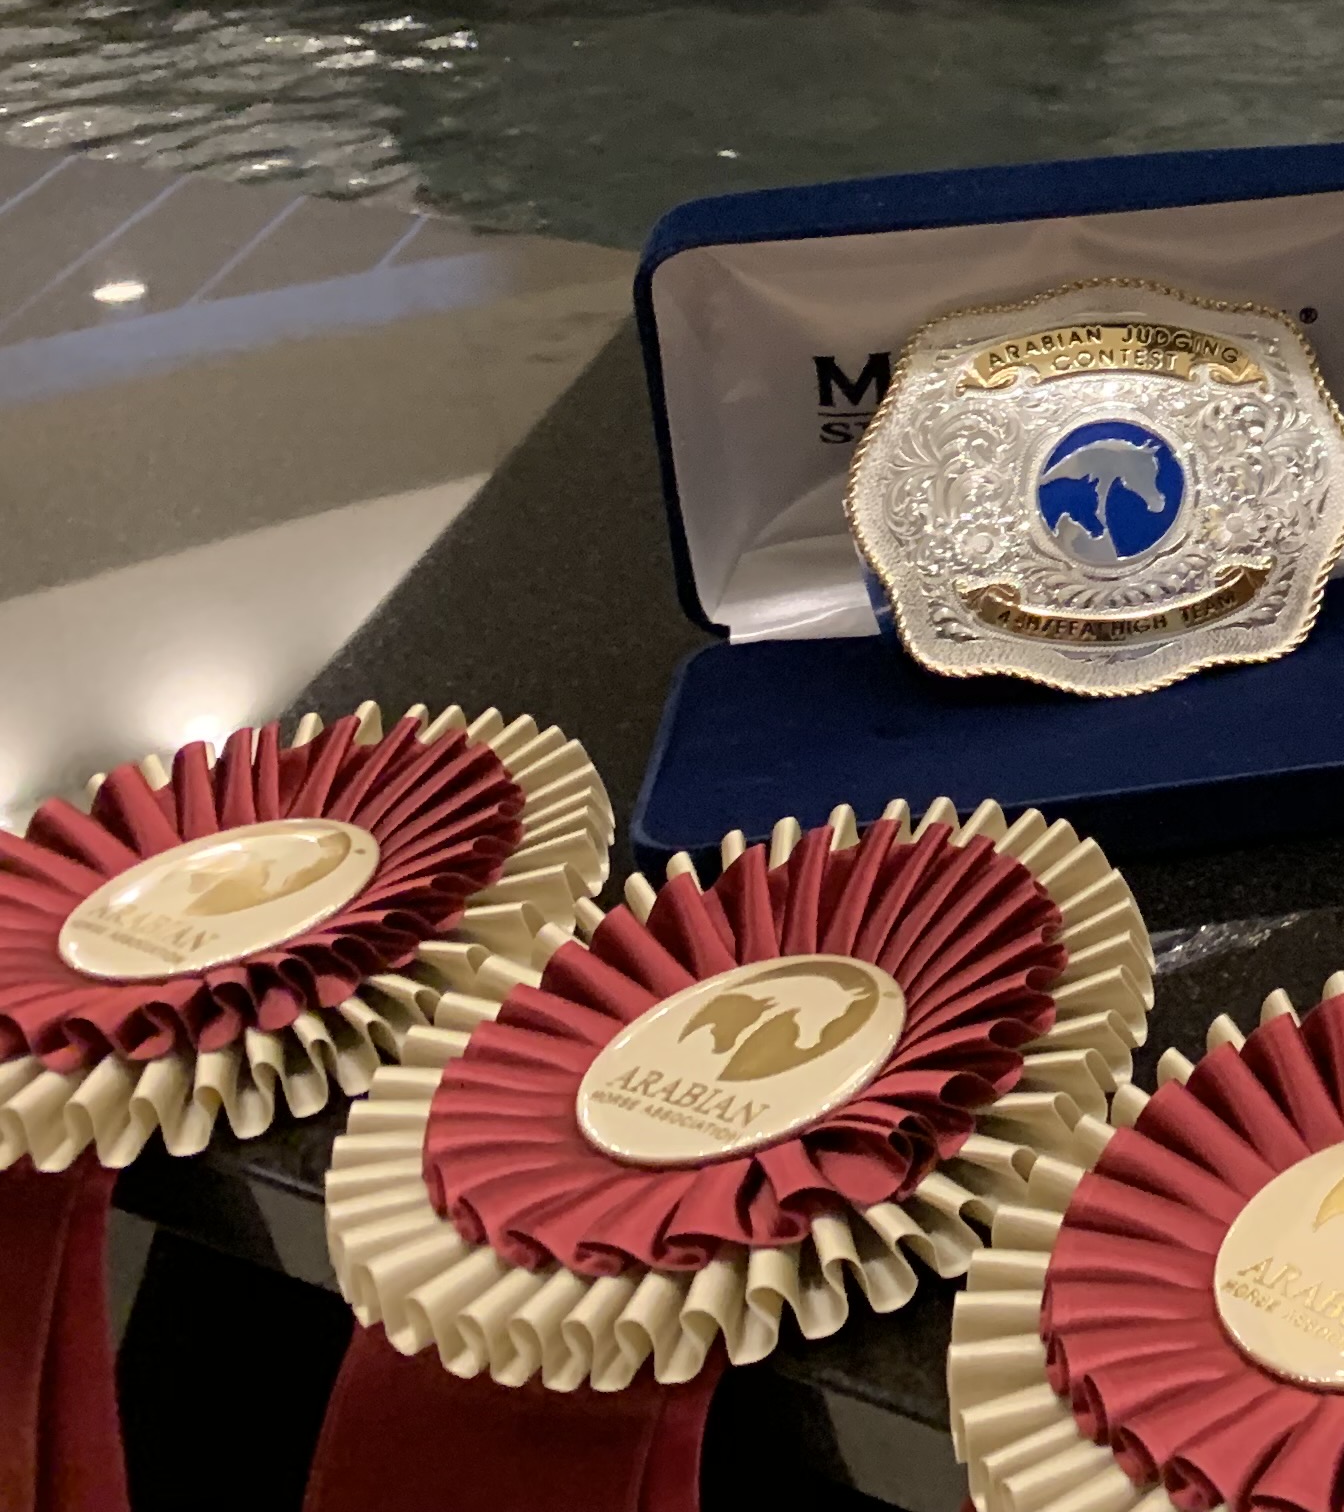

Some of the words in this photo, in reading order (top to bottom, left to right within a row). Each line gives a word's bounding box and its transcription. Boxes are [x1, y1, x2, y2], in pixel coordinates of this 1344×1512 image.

[988, 327, 1102, 369] ARABIAN
[1121, 325, 1239, 364] JUDGING
[1050, 348, 1178, 372] CONTEST
[1109, 614, 1168, 639] HIGH
[1180, 591, 1237, 627] TEAM
[605, 1065, 771, 1129] ARABIAN
